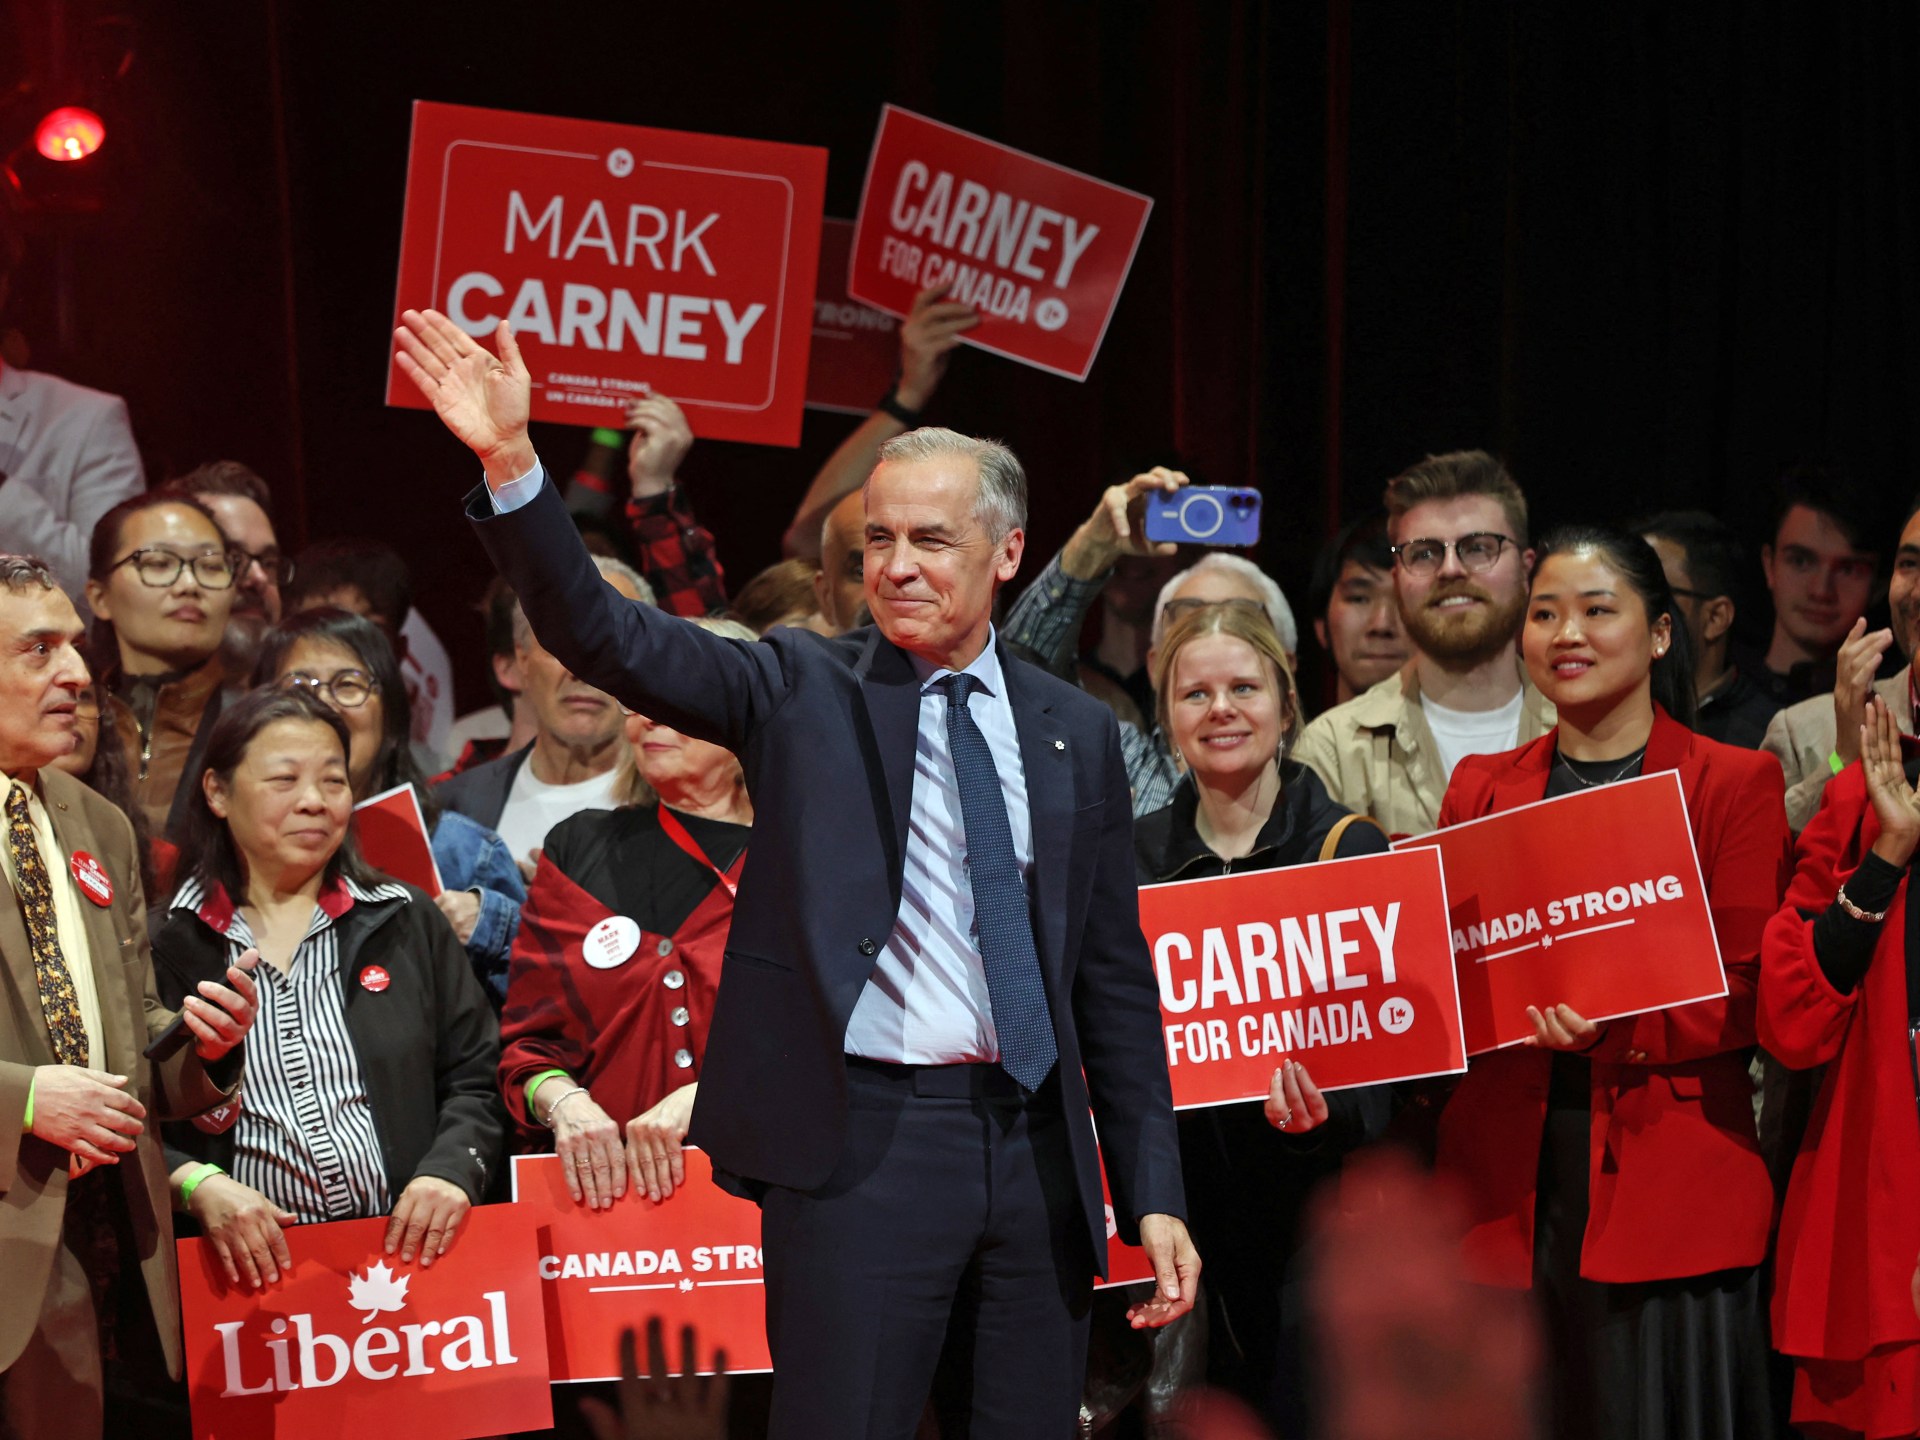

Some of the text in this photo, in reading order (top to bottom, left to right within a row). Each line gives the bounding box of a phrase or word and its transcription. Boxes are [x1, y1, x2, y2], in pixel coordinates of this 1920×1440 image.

[504, 190, 720, 276] MARK
[890, 160, 1101, 289] CARNEY
[447, 271, 766, 364] CARNEY
[879, 236, 1032, 324] FOR CANADA
[546, 390, 565, 402] UN
[566, 392, 616, 407] CANADA
[548, 372, 599, 387] CANADA
[1154, 901, 1401, 1013] CARNEY
[1453, 875, 1684, 953] ANADA STRONG
[1164, 1000, 1373, 1066] FOR CANADA
[539, 1245, 764, 1280] CANADA STR
[214, 1291, 518, 1398] Libéral
